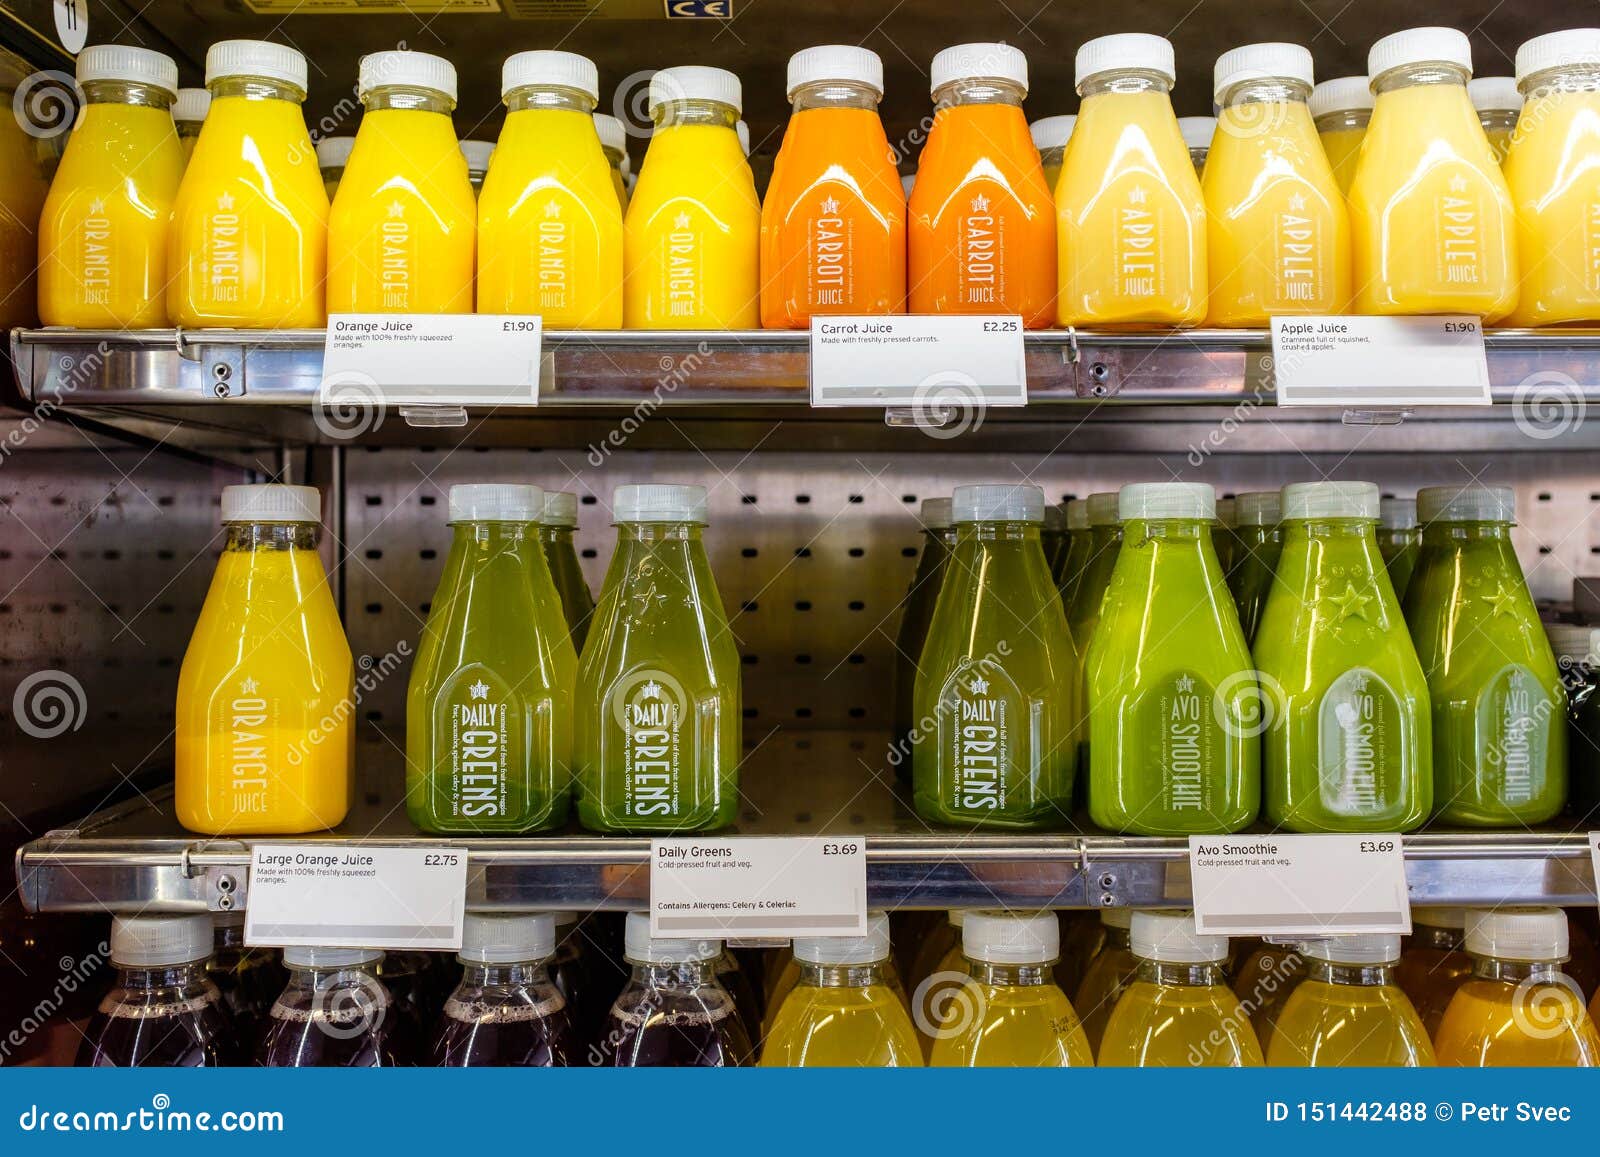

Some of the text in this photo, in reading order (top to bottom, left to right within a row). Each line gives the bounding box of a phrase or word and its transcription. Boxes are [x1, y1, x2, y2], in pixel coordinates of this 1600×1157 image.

[1444, 197, 1477, 261] APPLE
[212, 214, 239, 284] ORANGE
[967, 215, 994, 284] CARROT
[1122, 208, 1154, 273] APPLE
[1282, 214, 1313, 278] APPLE
[85, 218, 110, 286] ORANGE
[382, 222, 408, 290] ORANGE
[539, 222, 566, 290] ORANGE
[817, 218, 844, 286] CARROT
[669, 232, 695, 298] ORANGE
[1446, 265, 1478, 283] JUICE
[213, 286, 238, 302] JUICE
[968, 287, 994, 303] JUICE
[1123, 277, 1155, 296] JUICE
[1284, 282, 1315, 301] JUICE
[817, 289, 844, 305] JUICE
[336, 321, 413, 333] Orange Juice
[503, 321, 535, 332] £1.90
[821, 323, 893, 334] Carrot Juice
[983, 322, 1018, 332] £2.25
[1281, 323, 1348, 335] Apple Juice
[1444, 322, 1475, 333] £1.90
[334, 334, 453, 343] Made with 100% freshly squeezed
[841, 336, 857, 344] with
[858, 336, 882, 344] freshly
[883, 336, 911, 344] pressed
[912, 335, 940, 343] carrots.
[1281, 336, 1371, 345] Crammed full of squished,
[1281, 343, 1310, 351] crushed
[962, 699, 997, 721] DAILY
[1171, 695, 1200, 721] AVO
[1504, 690, 1529, 715] AVO
[462, 703, 498, 726] DAILY
[633, 703, 669, 726] DAILY
[231, 698, 268, 789] ORANGE
[462, 730, 498, 816] GREENS
[634, 730, 671, 816] GREENS
[962, 725, 998, 809] GREENS
[1171, 723, 1202, 811] SMOOTHIE
[232, 793, 268, 813] JUICE
[659, 846, 732, 859] Daily Greens
[823, 844, 858, 855] £3.69
[1197, 843, 1278, 855] Avo Smoothie
[1360, 841, 1394, 852] £3.69
[258, 854, 373, 867] Large Orange Juice
[424, 855, 458, 866] £2.75
[658, 860, 752, 869] Cold-pressed fruit and veg.
[1197, 858, 1292, 867] Cold-pressed fruit and veg.
[257, 868, 376, 877] Made with 100% freshly squeezed
[658, 901, 797, 910] Contains Allergens: Celery & Celeriac
